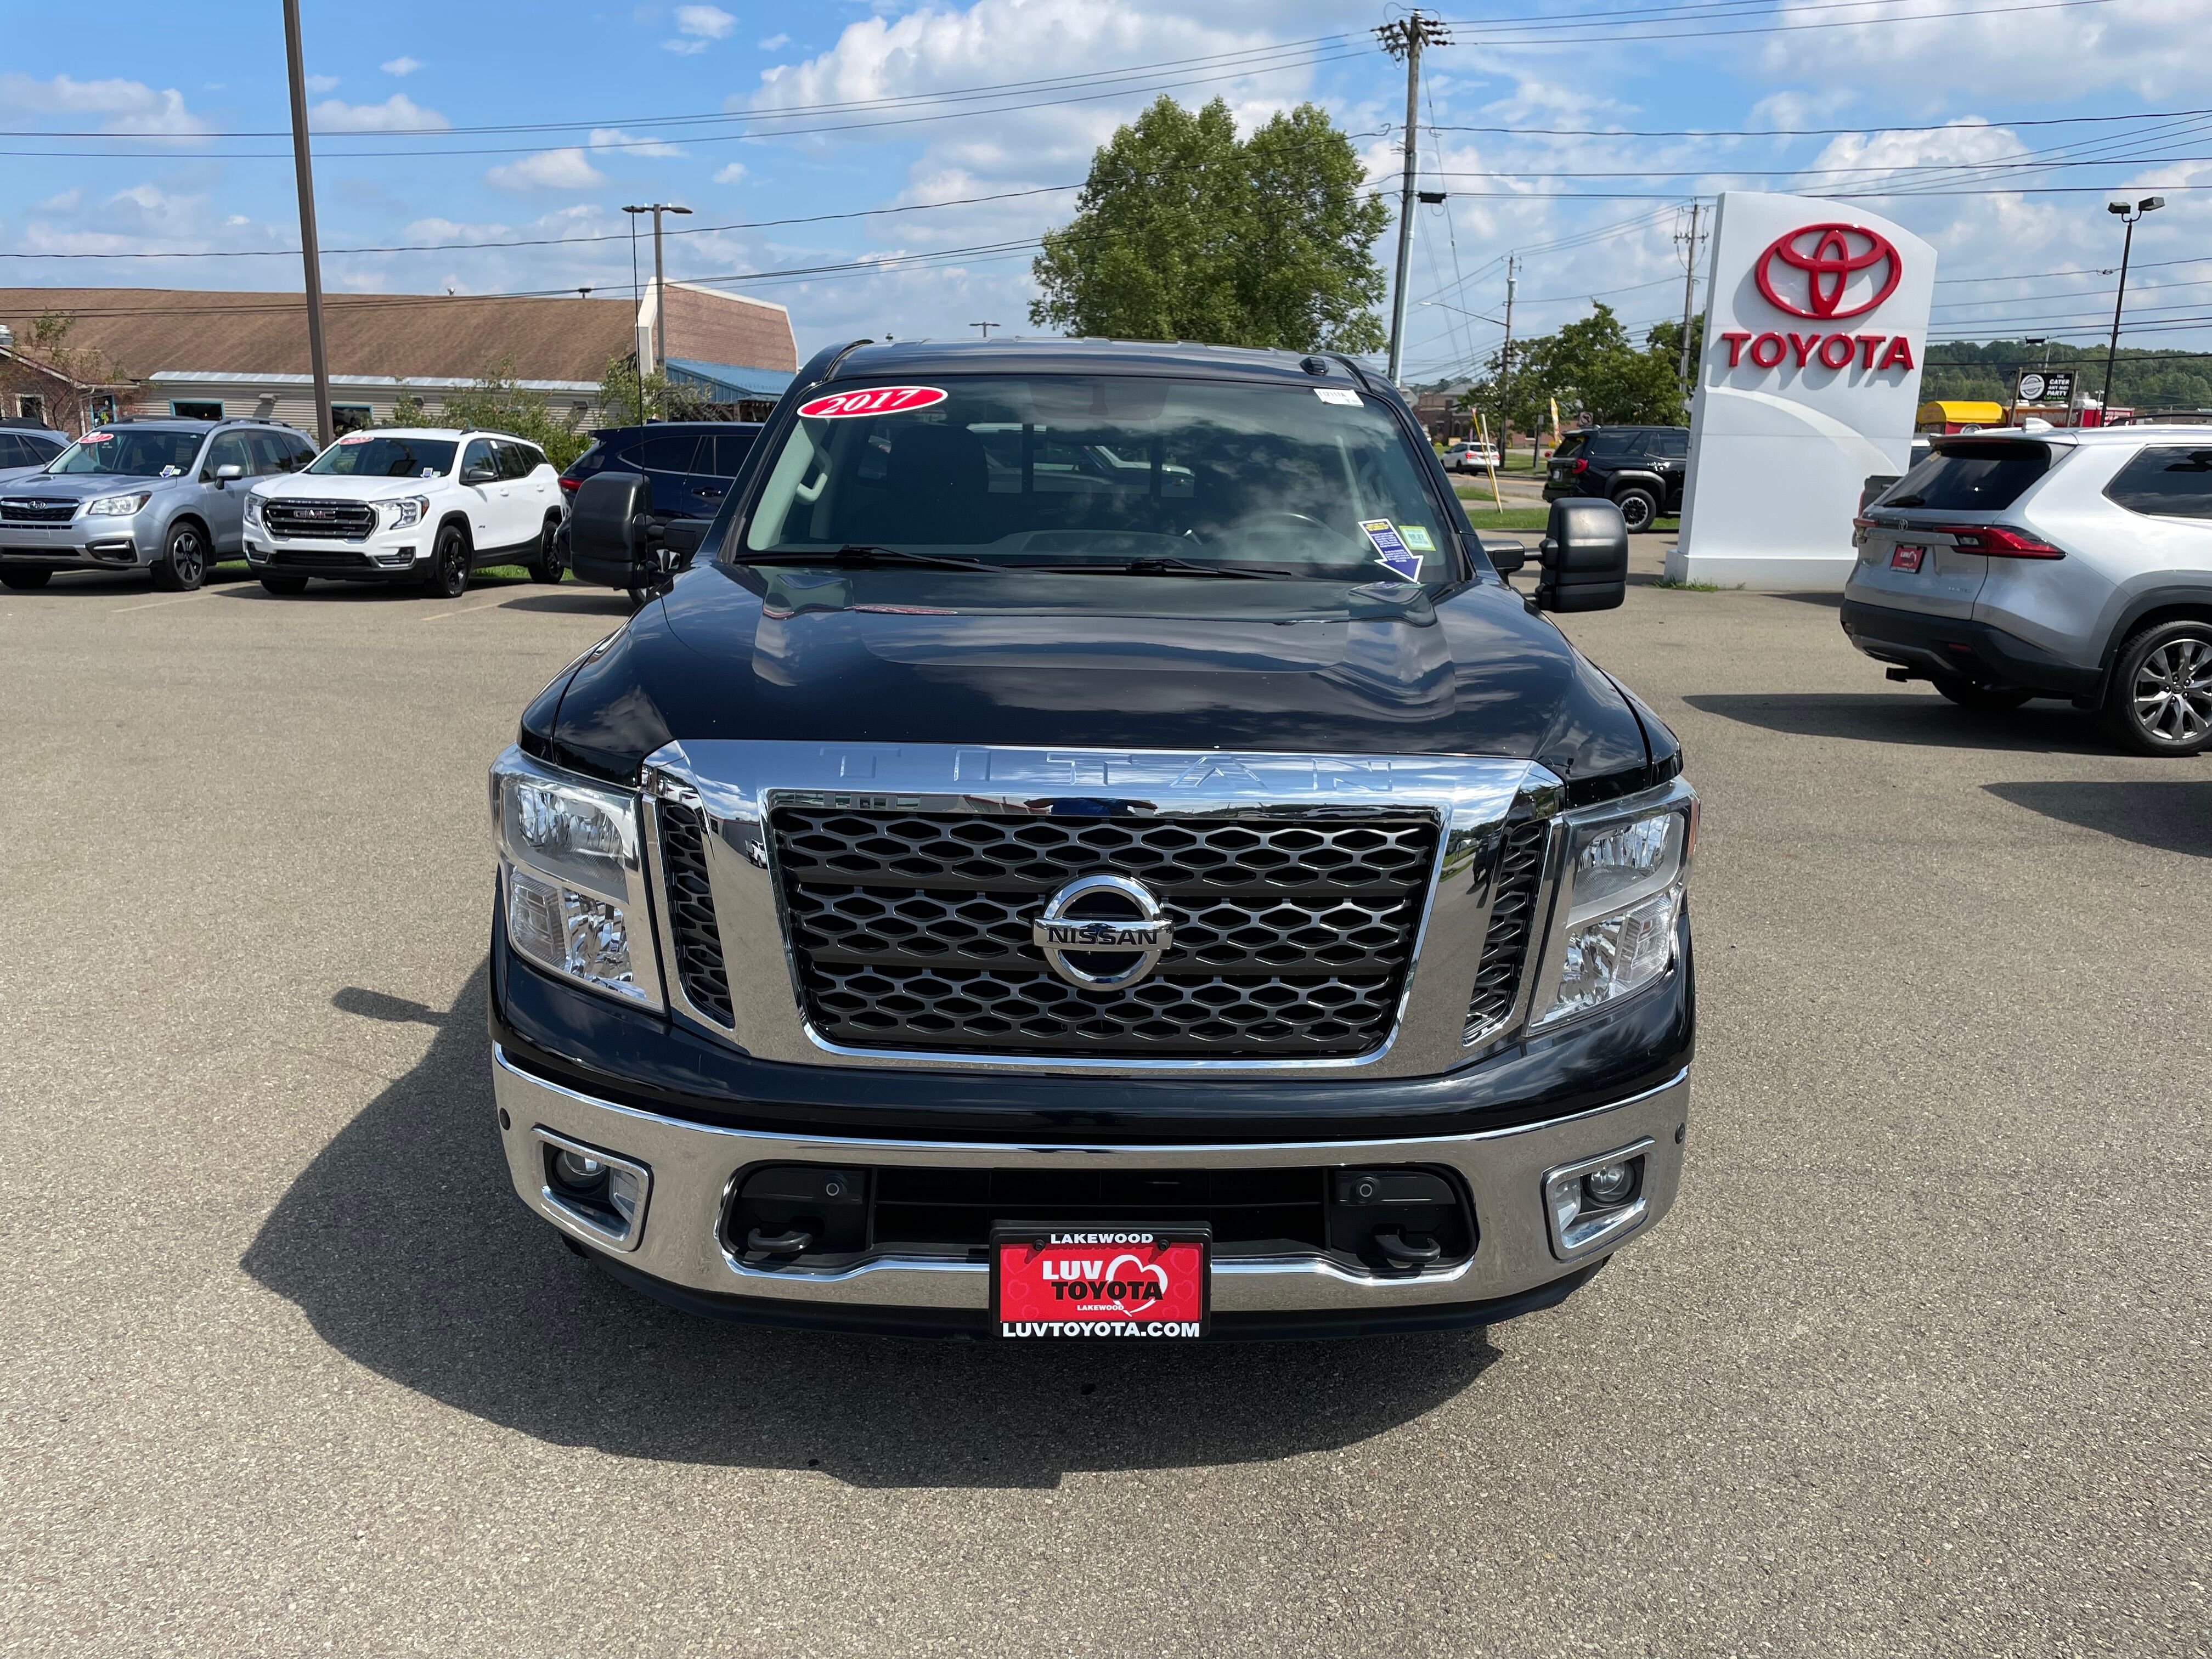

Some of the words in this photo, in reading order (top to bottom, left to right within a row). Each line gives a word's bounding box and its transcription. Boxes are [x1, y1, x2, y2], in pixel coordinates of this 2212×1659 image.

[1722, 332, 1915, 370] TOYOTA
[816, 390, 921, 415] 2017
[821, 748, 1392, 792] TITAN
[1048, 927, 1157, 945] NISSAN
[1051, 1233, 1153, 1244] LAKEWOOD
[1042, 1260, 1103, 1280] LUV
[1051, 1281, 1164, 1300] TOYOTA
[1002, 1322, 1199, 1337] LUVTOYOTA.COM
